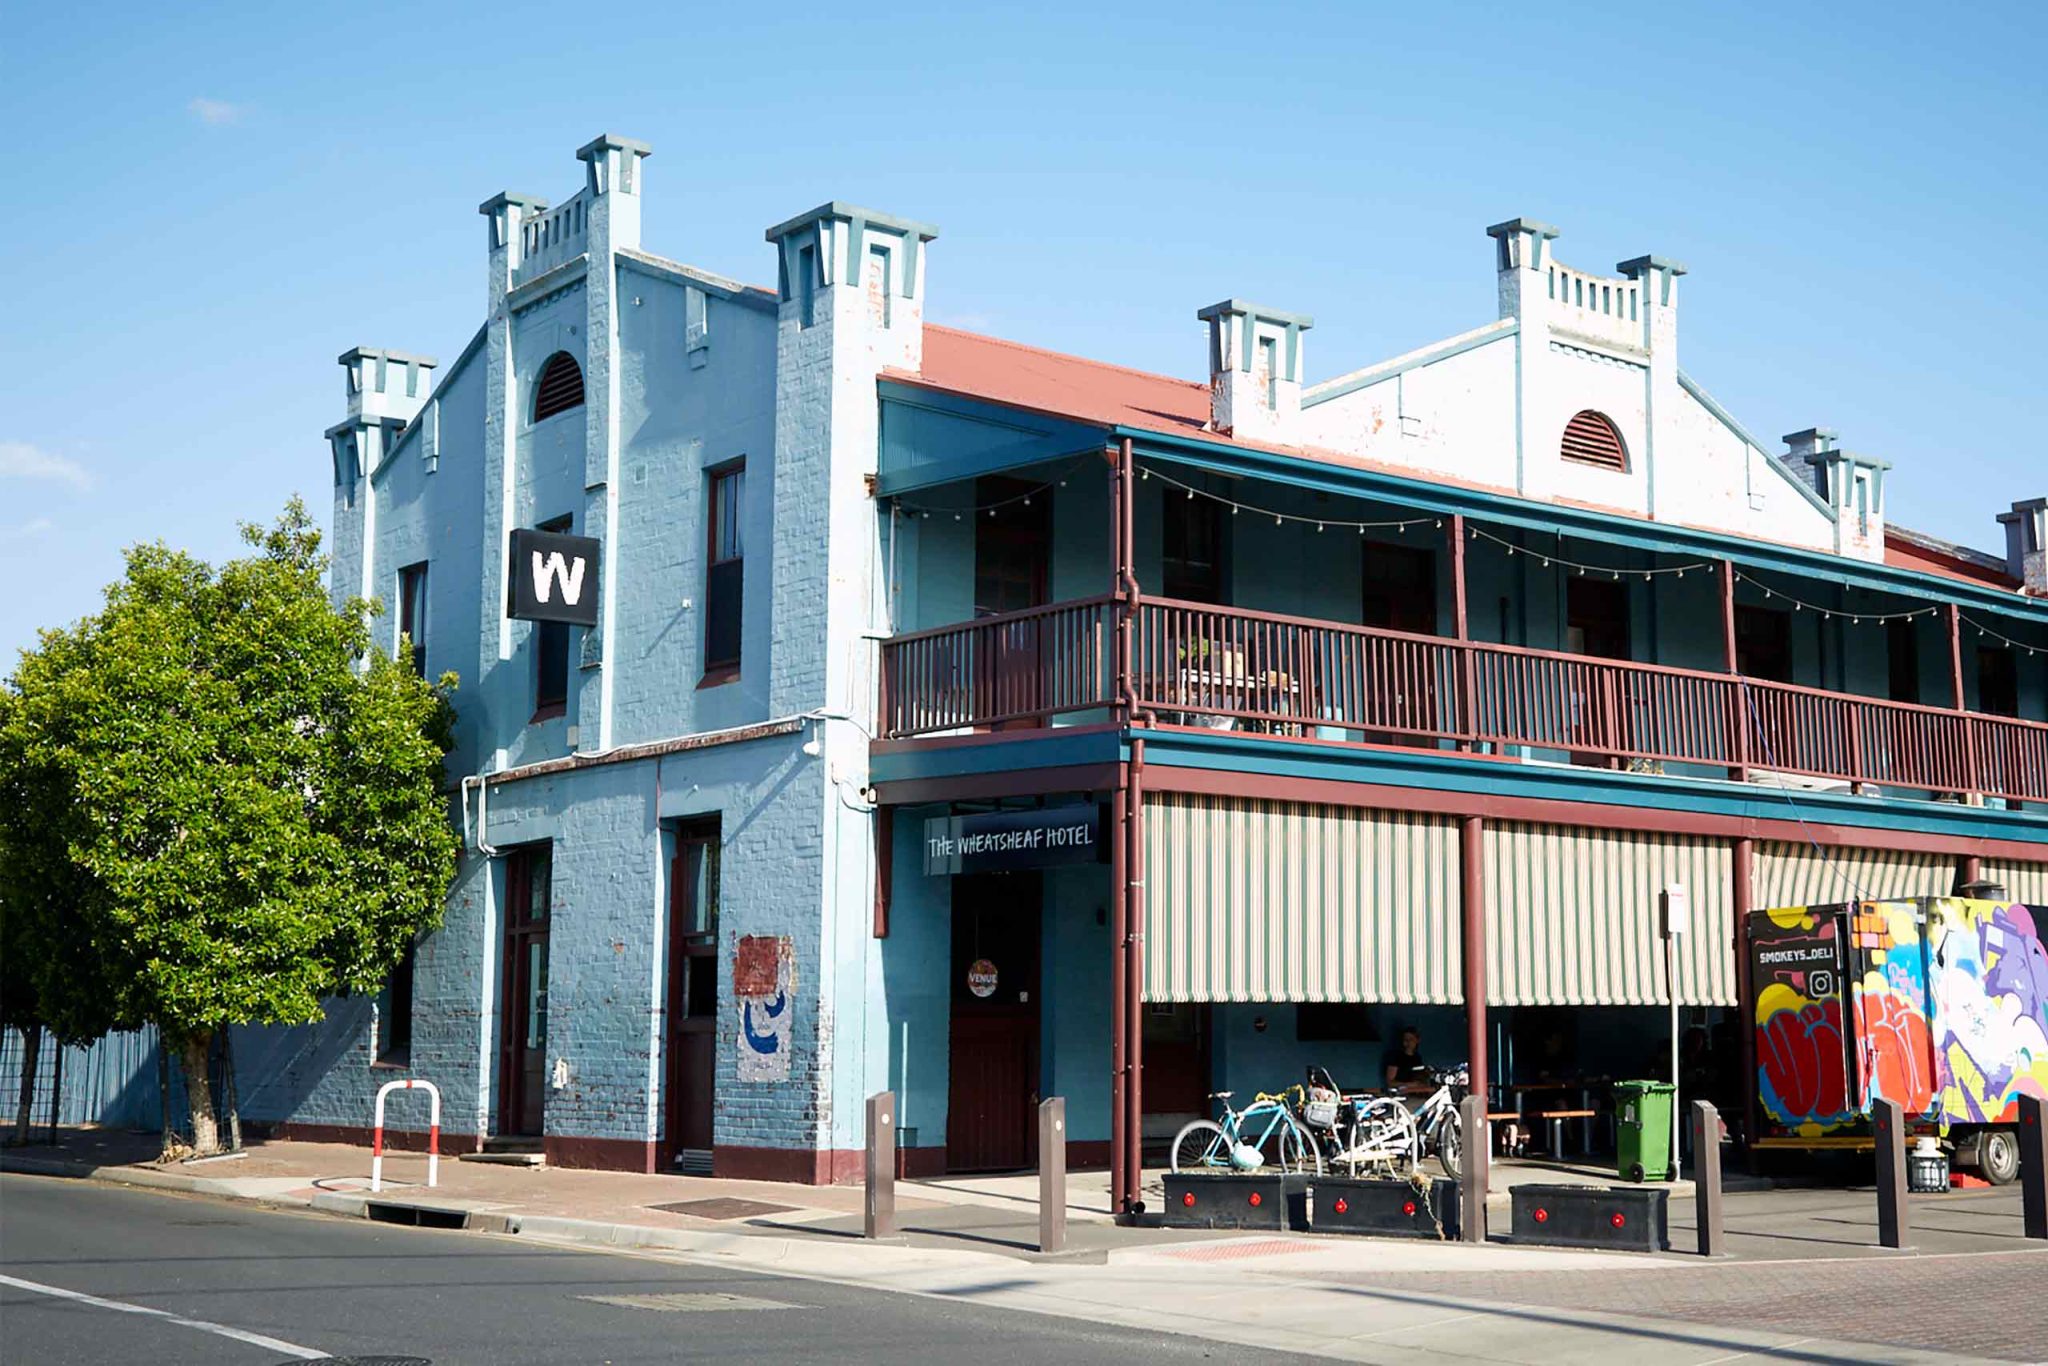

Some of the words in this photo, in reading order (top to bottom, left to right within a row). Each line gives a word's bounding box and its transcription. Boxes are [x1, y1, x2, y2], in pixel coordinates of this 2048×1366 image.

[532, 551, 585, 606] W
[928, 835, 953, 857] THE
[958, 829, 1043, 854] WHEATSHEAF
[1046, 823, 1093, 848] HOTEL
[1759, 947, 1834, 964] SMOKEYS_DELI
